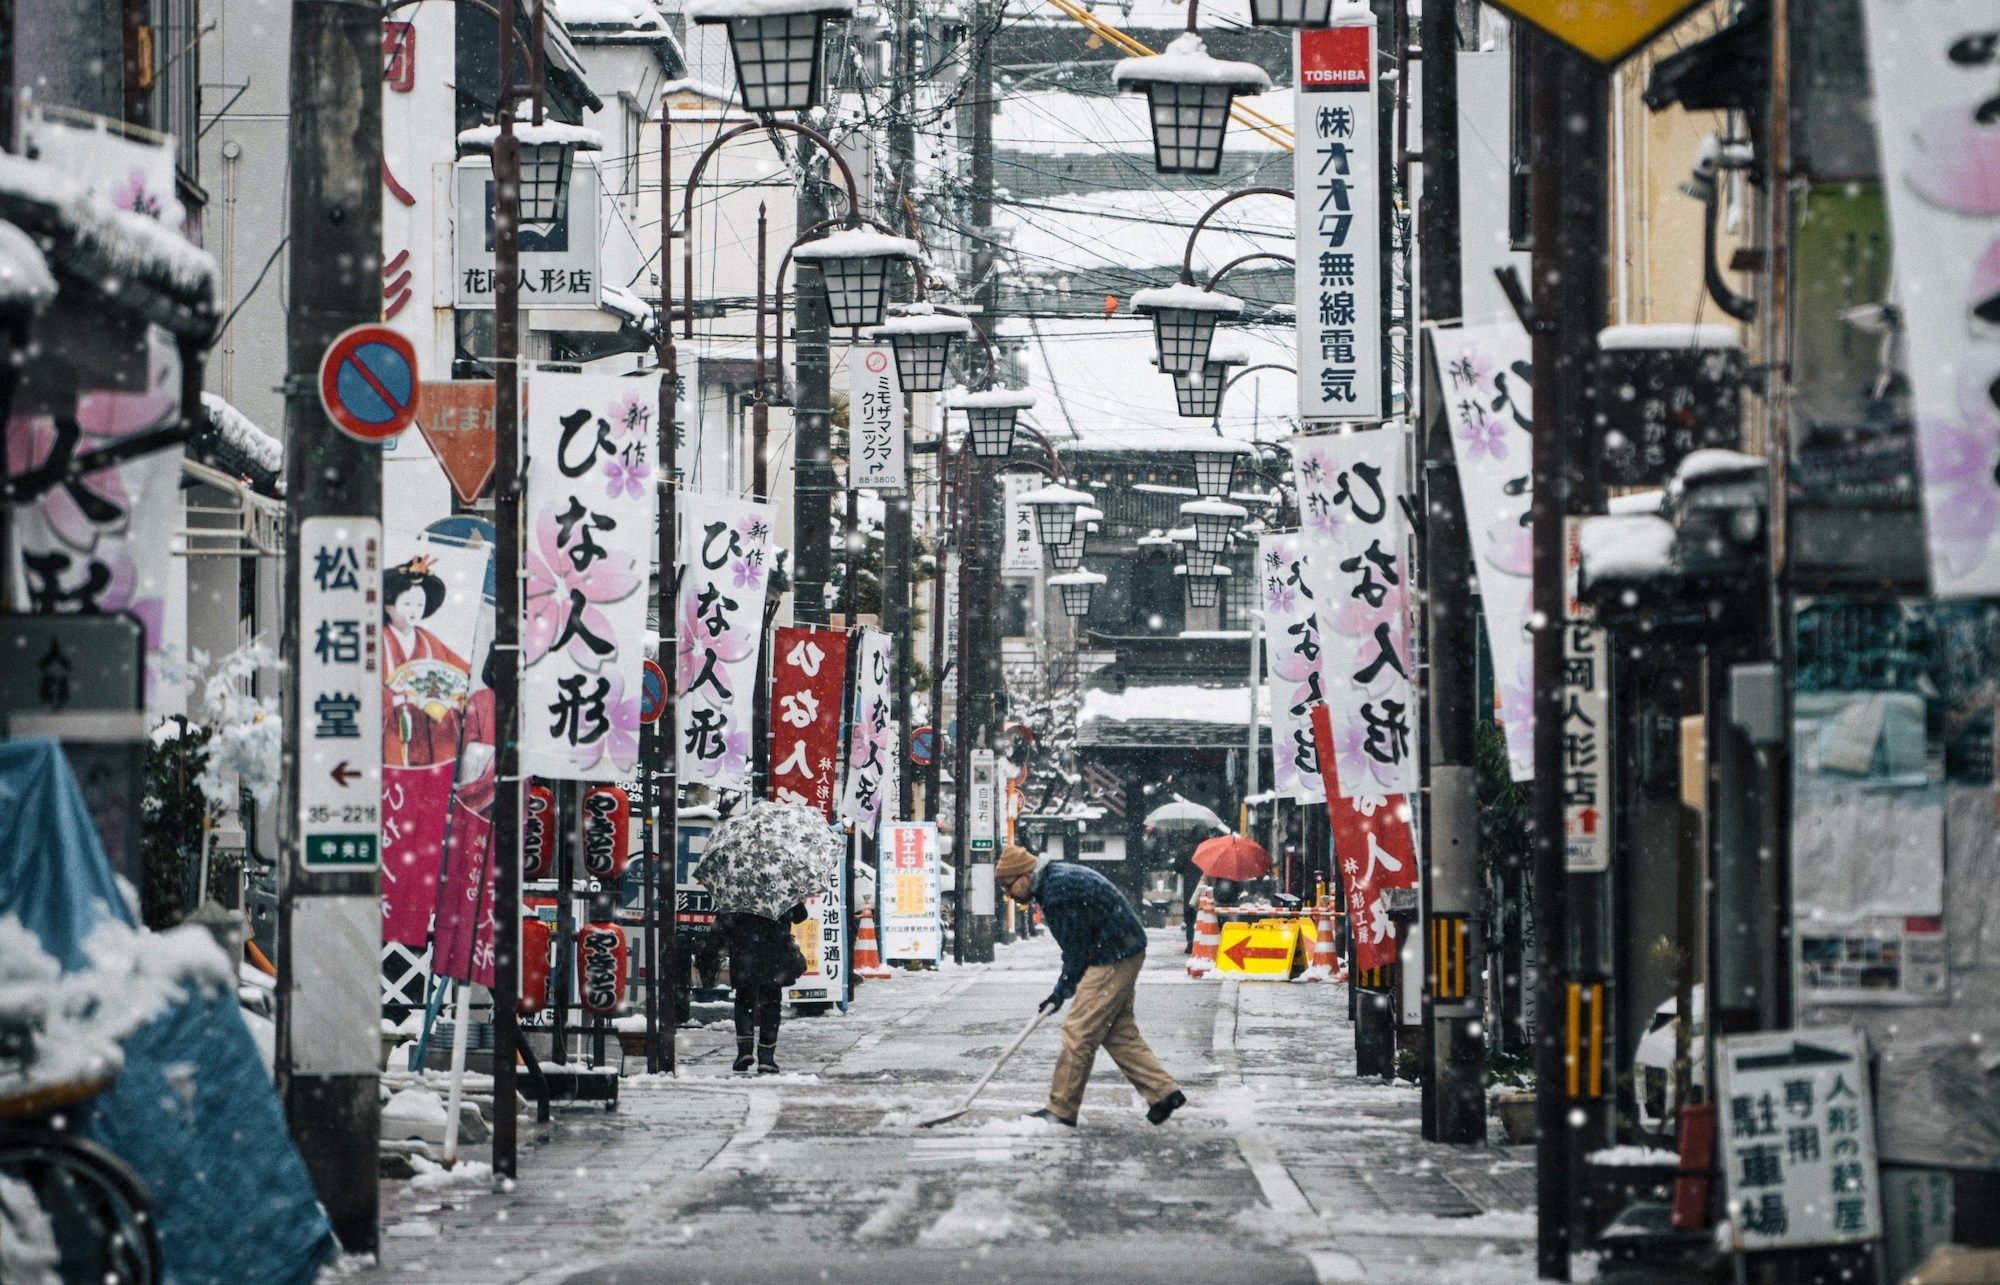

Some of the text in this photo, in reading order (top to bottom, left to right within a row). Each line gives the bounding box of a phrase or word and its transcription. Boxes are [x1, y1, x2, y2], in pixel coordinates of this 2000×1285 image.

[1305, 69, 1366, 81] TOSHIBA
[622, 402, 650, 468] 新作
[862, 391, 876, 460] クリニック
[877, 376, 892, 460] ミモザマンマ
[858, 476, 896, 484] 88-3800
[548, 408, 618, 747] ひな人形
[747, 521, 770, 567] 新作
[684, 520, 744, 760] ひな人形
